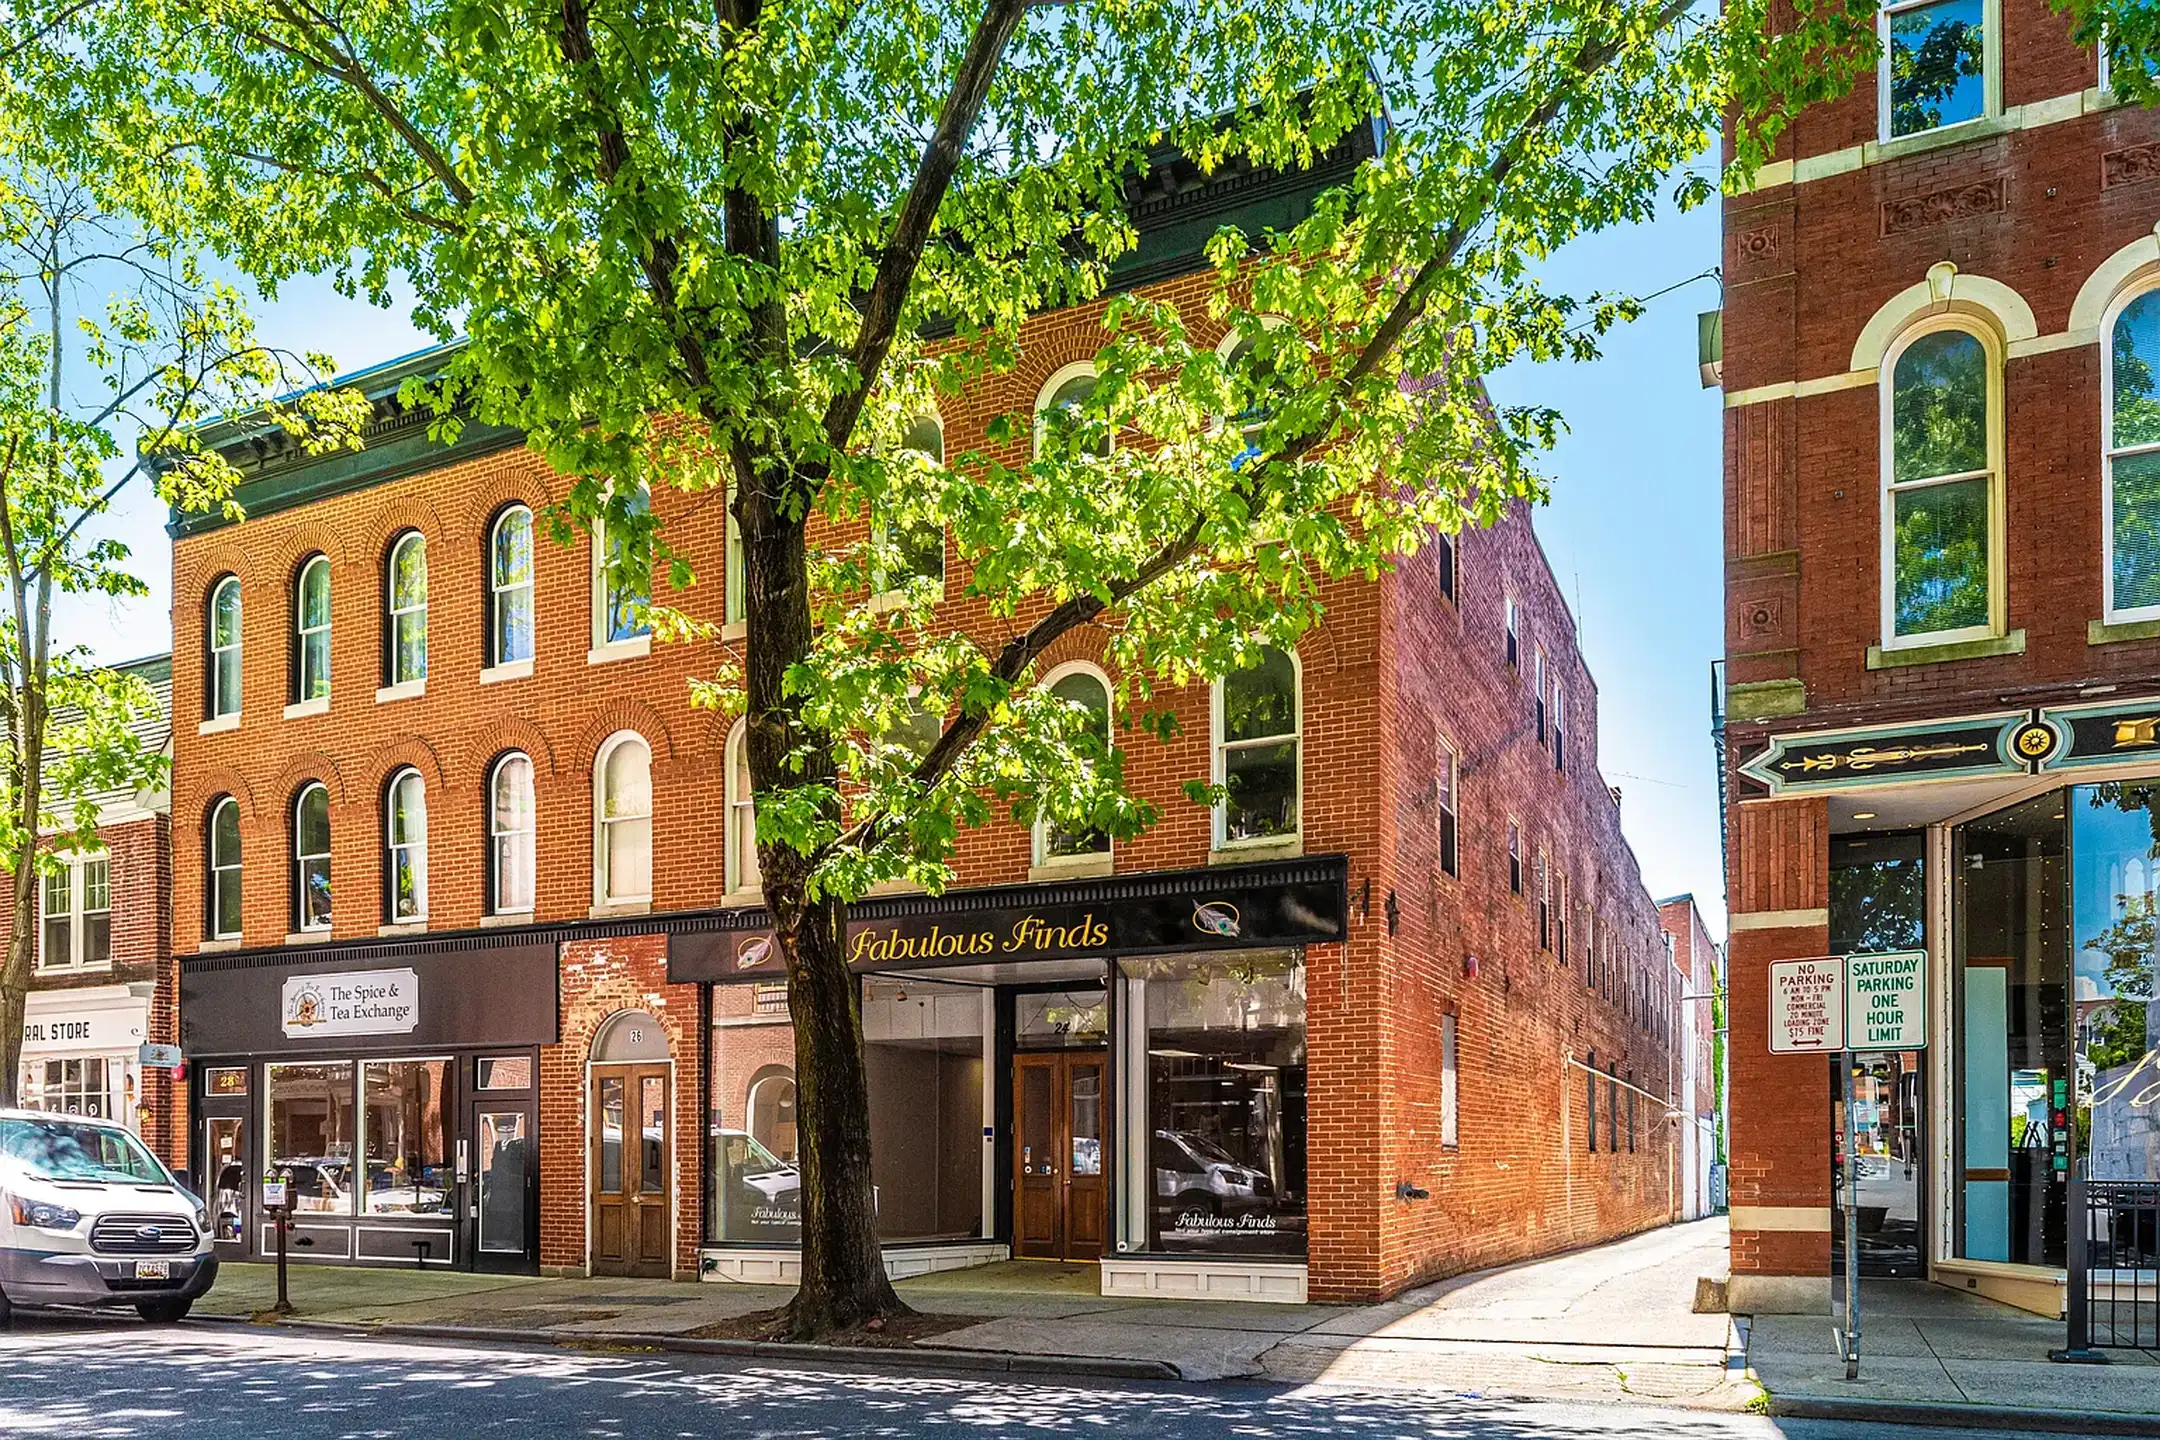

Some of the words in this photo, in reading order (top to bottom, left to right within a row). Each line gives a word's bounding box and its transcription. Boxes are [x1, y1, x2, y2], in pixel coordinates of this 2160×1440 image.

[846, 926, 994, 963] Fabulous
[1002, 913, 1109, 953] Finds
[1798, 964, 1815, 975] NO
[1852, 958, 1919, 977] SATURDAY
[1779, 973, 1834, 987] PARKING
[1857, 976, 1914, 993] PARKING
[330, 985, 352, 1001] The
[354, 983, 386, 1003] Spice
[388, 982, 400, 998] &
[1790, 986, 1801, 995] AM
[1802, 985, 1812, 993] TO
[1821, 984, 1832, 993] PM
[1791, 995, 1804, 1003] MON
[1812, 994, 1823, 1002] FRI
[1871, 993, 1899, 1009] ONE
[330, 1005, 350, 1020] Tea
[354, 1003, 410, 1022] Exchange
[1786, 1002, 1826, 1011] COMMERCIAL
[1790, 1011, 1799, 1019] 20
[1801, 1010, 1823, 1018] MINUTE
[1867, 1010, 1904, 1026] HOUR
[1054, 1021, 1071, 1035] 24
[1783, 1019, 1810, 1027] LOADING
[1812, 1017, 1830, 1026] ZONE
[25, 1024, 46, 1042] RAL
[51, 1021, 90, 1040] STORE
[630, 1030, 643, 1042] 26
[1807, 1025, 1824, 1036] FINE
[1868, 1027, 1902, 1042] LIMIT
[220, 1075, 235, 1087] 28
[1175, 1212, 1234, 1228] Fabulous
[1236, 1211, 1277, 1229] Finds
